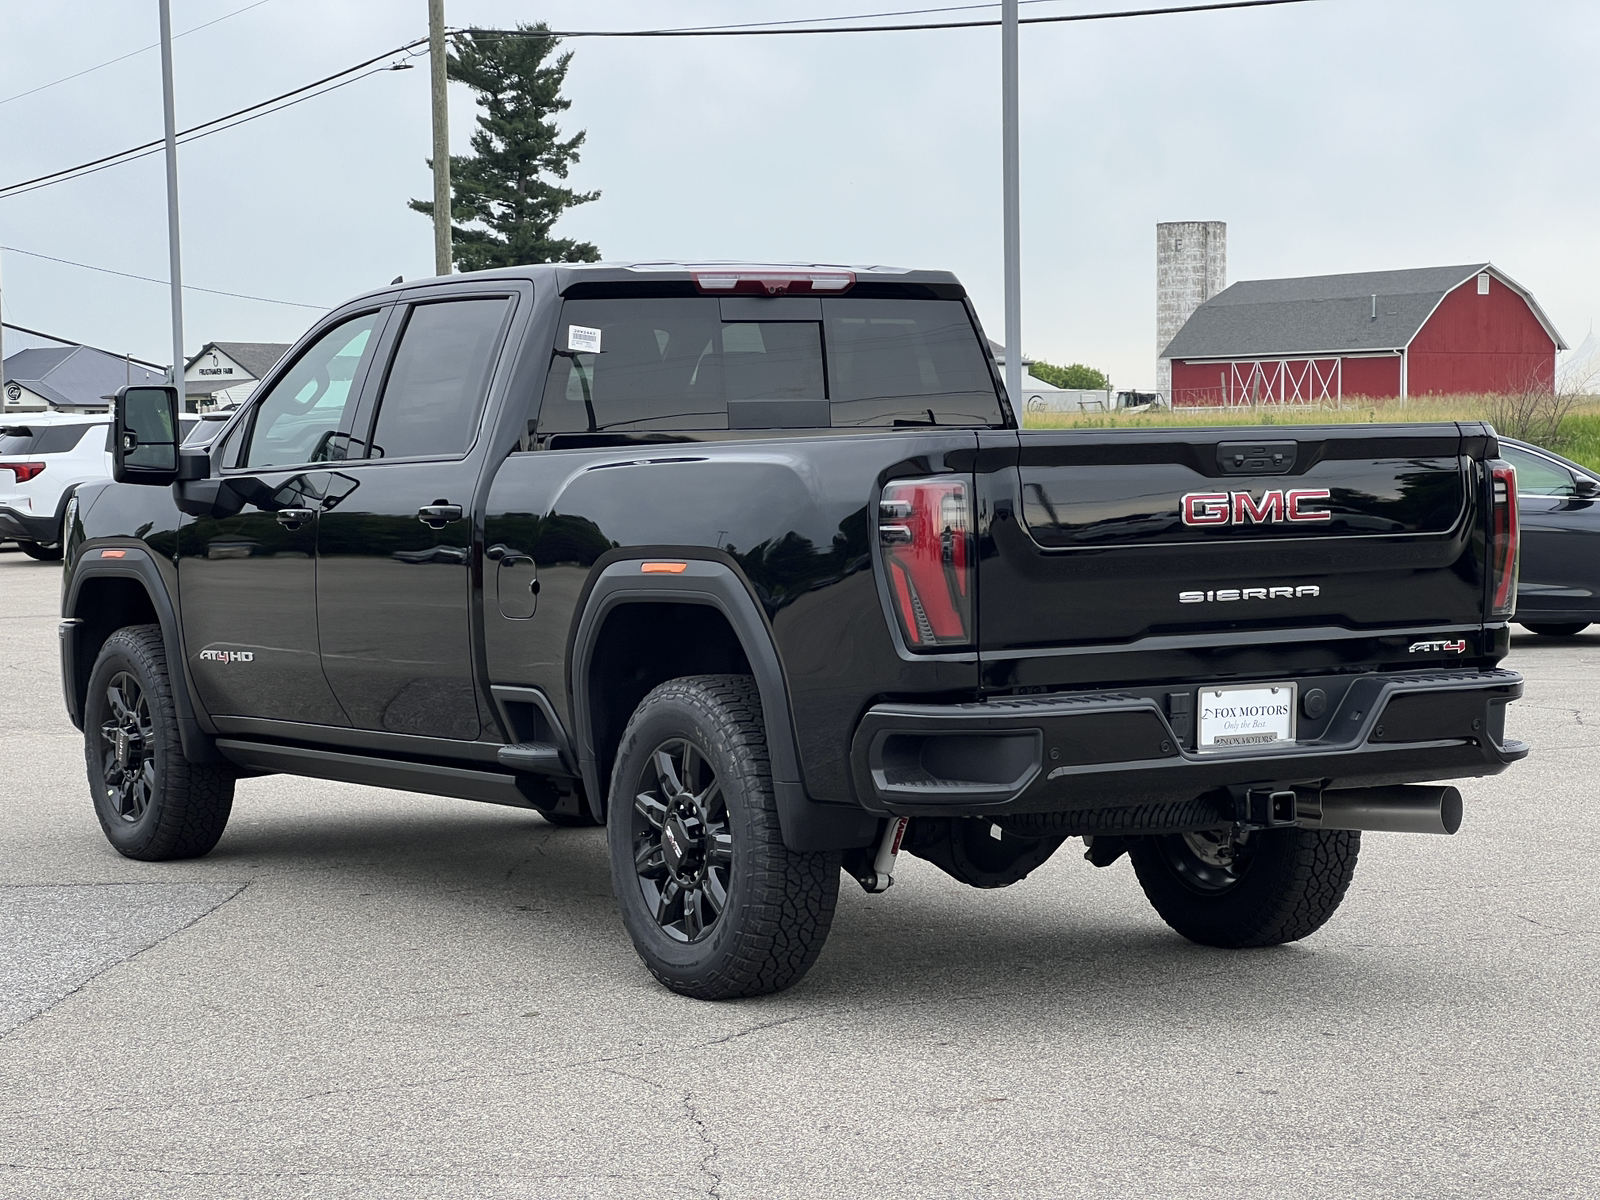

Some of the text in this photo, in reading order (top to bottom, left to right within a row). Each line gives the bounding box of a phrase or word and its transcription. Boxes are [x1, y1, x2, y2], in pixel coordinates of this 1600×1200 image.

[1180, 488, 1332, 526] GMC
[1179, 585, 1320, 604] SIERRA
[1408, 640, 1466, 654] AT4
[1214, 704, 1289, 719] FOX MOTORS
[1223, 720, 1240, 732] Only
[1240, 719, 1251, 729] the
[1241, 735, 1274, 745] MOTORS
